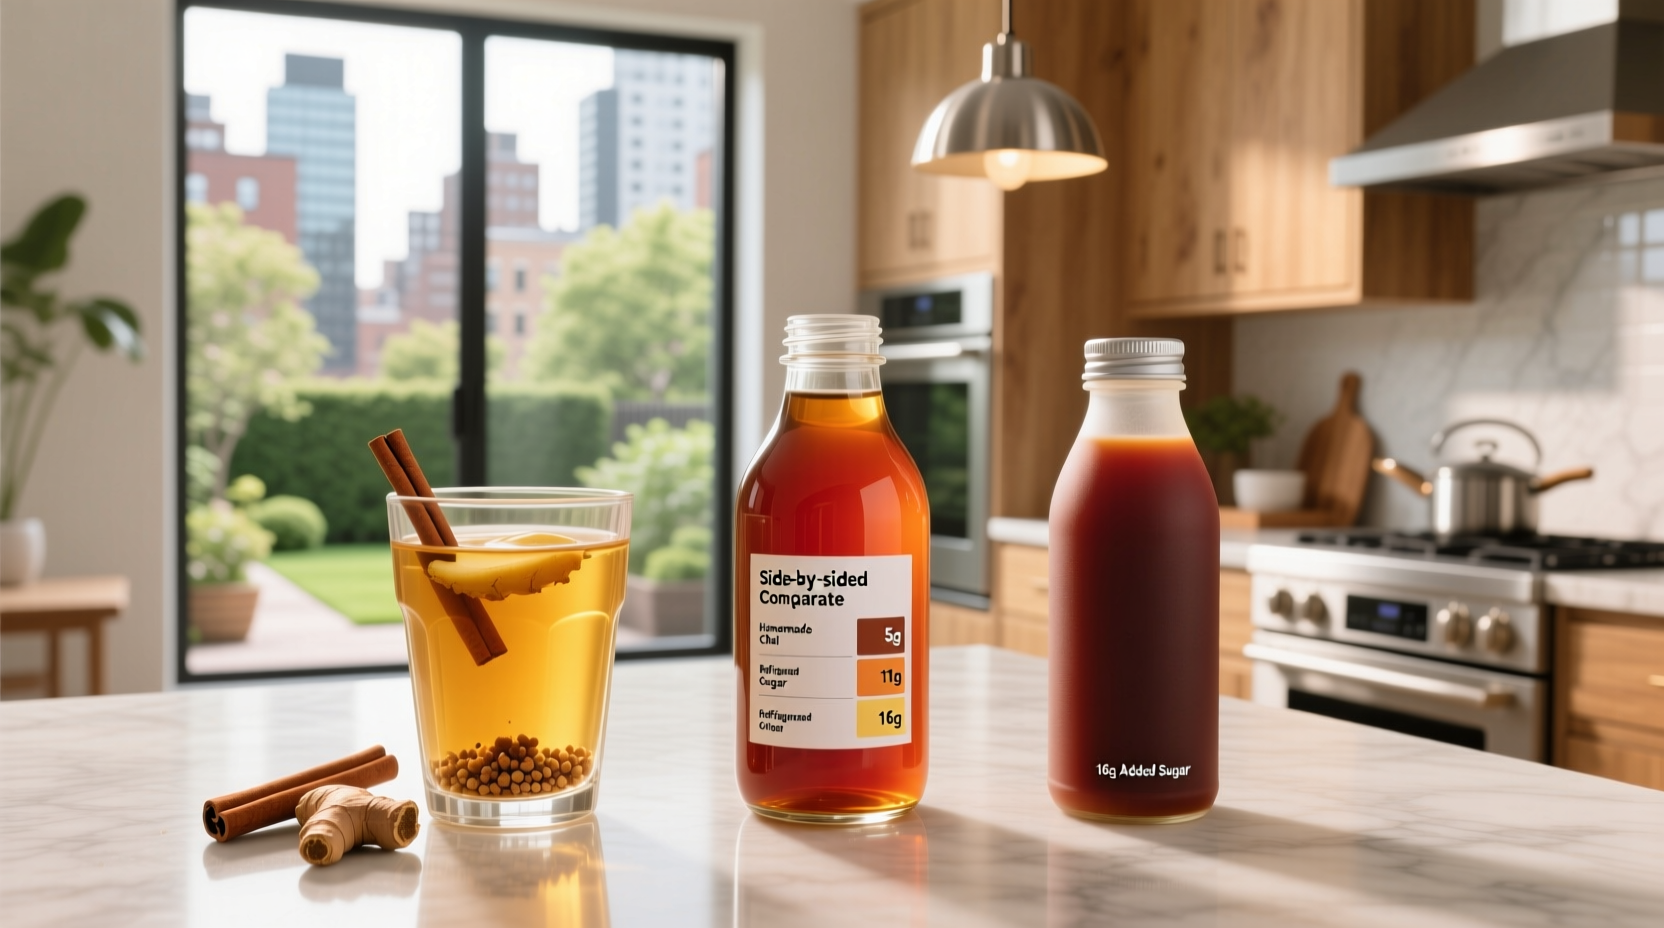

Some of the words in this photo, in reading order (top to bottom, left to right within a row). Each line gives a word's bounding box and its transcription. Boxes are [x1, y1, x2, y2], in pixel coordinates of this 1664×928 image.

[759, 569, 868, 592] Side-by-sided
[759, 589, 845, 609] Comparate
[884, 627, 902, 646] 5g
[880, 668, 902, 686] 11g
[878, 710, 902, 729] 16g
[1096, 763, 1117, 779] 16g
[1119, 763, 1156, 776] Added
[1158, 764, 1192, 779] Sugar
